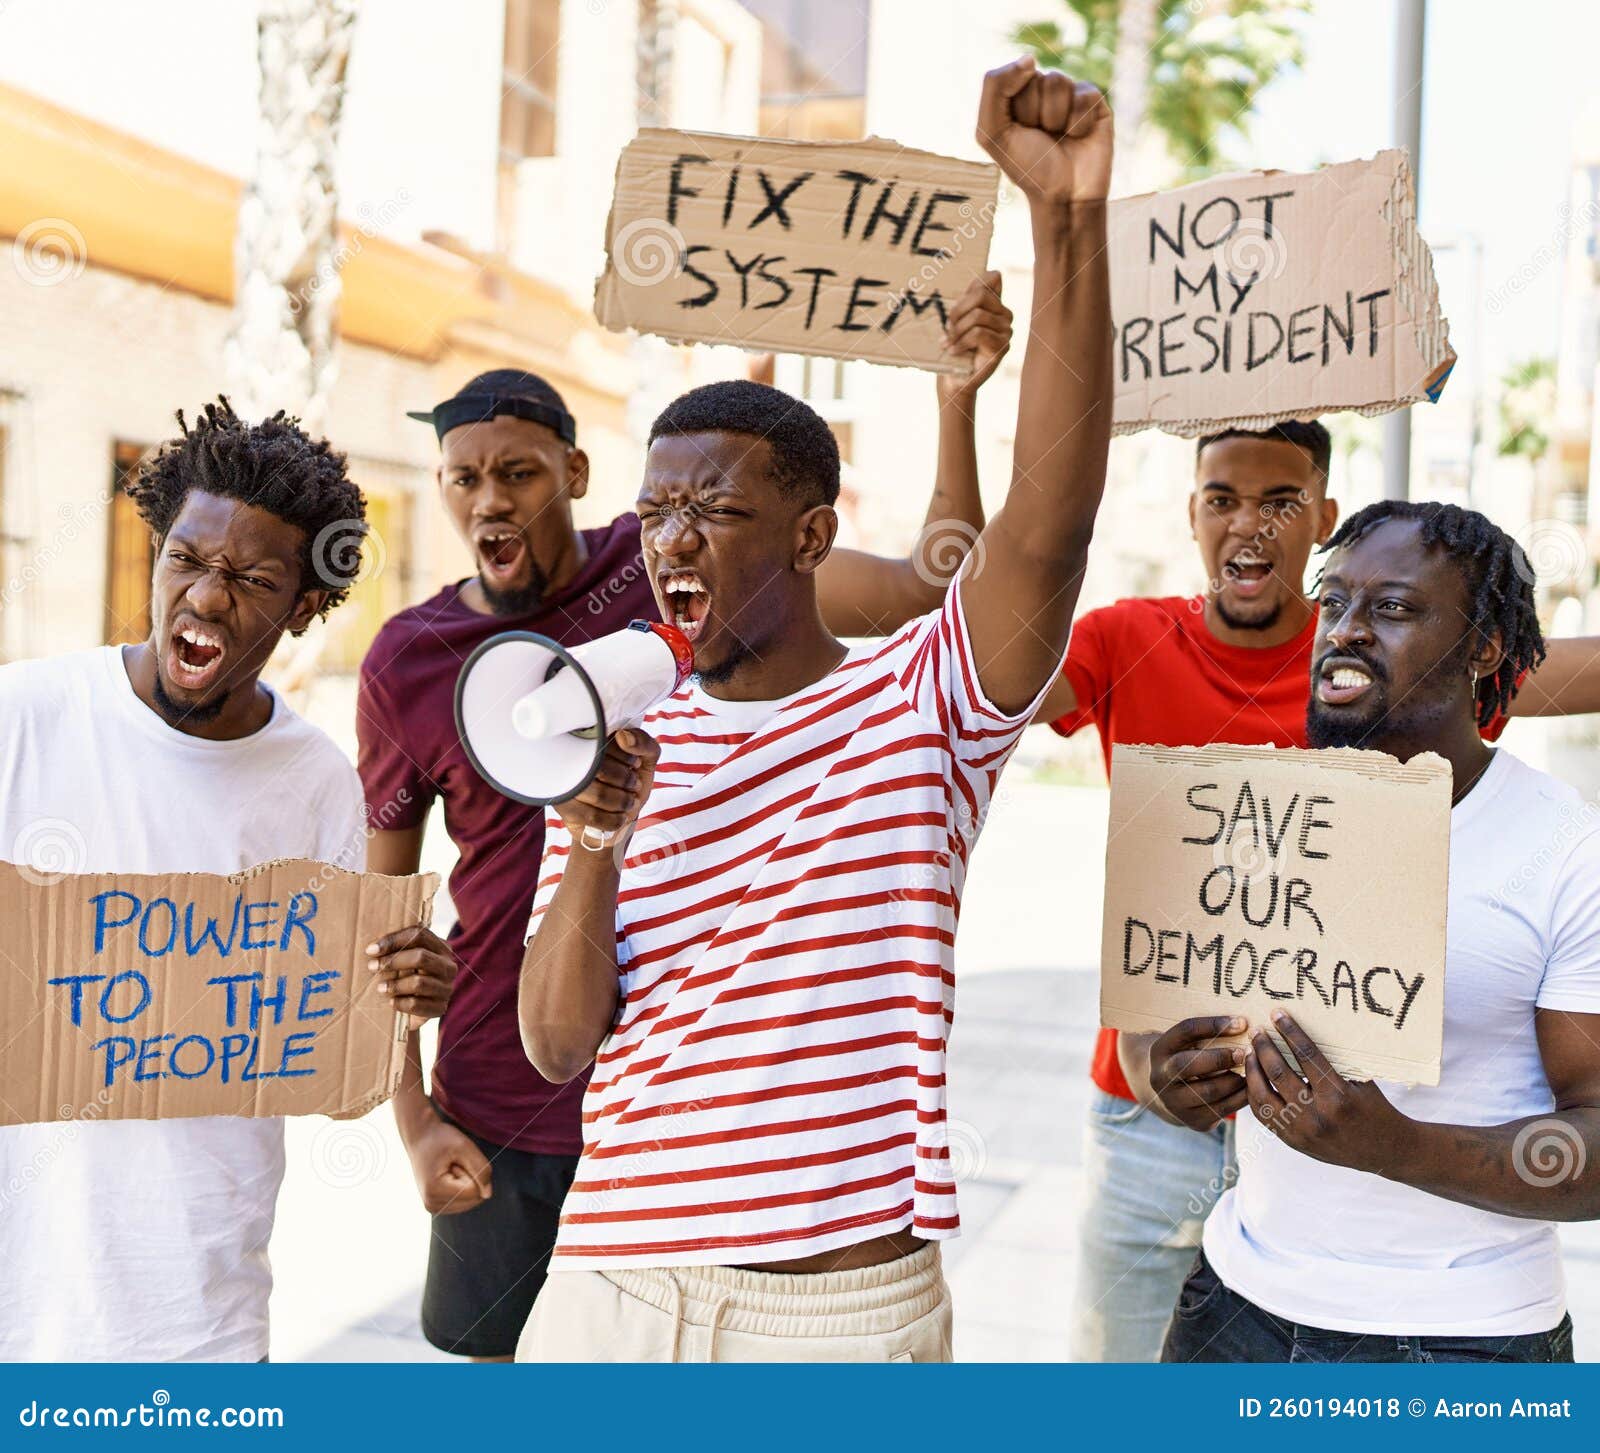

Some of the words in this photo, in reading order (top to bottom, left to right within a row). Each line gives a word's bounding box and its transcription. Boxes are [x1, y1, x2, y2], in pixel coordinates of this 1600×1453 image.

[667, 150, 815, 232] FIX
[835, 169, 972, 259] THE
[1149, 190, 1295, 264] NOT
[677, 244, 950, 332] SYSTEM
[1173, 262, 1259, 316] MY
[1112, 287, 1391, 383] RESIDENT
[1182, 780, 1336, 859] SAVE
[88, 889, 319, 958] POWER
[1198, 864, 1325, 937] OUR
[47, 969, 154, 1028] TO
[207, 970, 342, 1031] THE
[1123, 916, 1426, 1031] DEMOCRACY
[90, 1031, 317, 1088] PEOPLE
